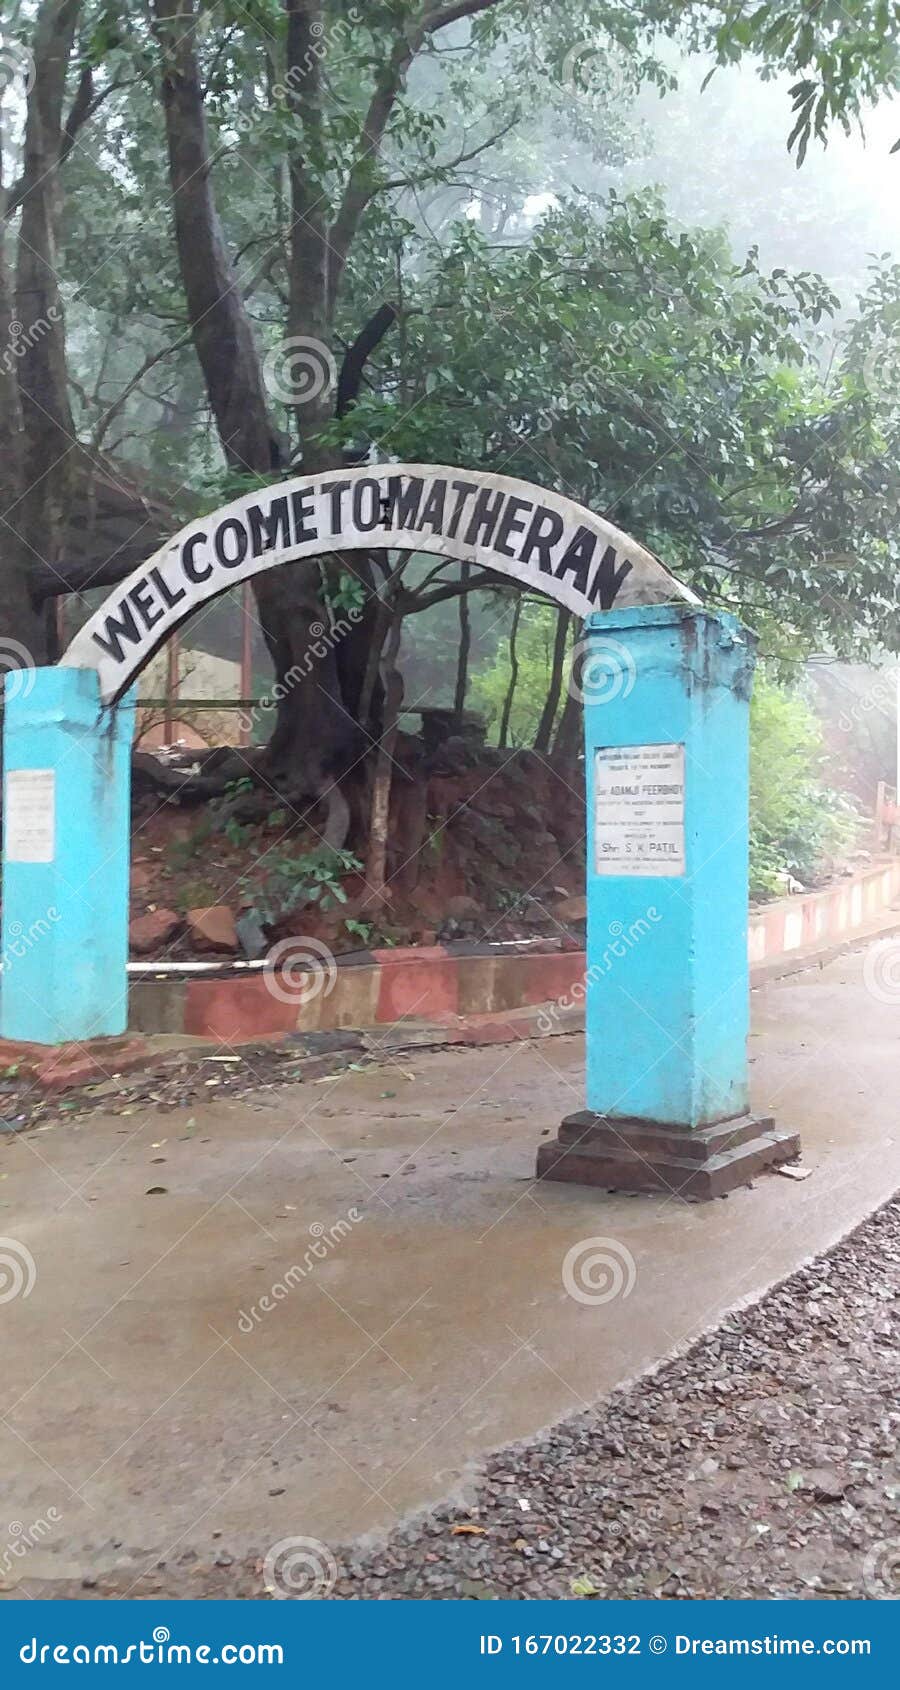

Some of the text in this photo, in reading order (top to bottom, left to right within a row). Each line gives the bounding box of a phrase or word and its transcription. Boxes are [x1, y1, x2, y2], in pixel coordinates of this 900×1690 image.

[92, 475, 634, 664] WELCOME TO MATHERAN
[649, 842, 679, 853] PATIL
